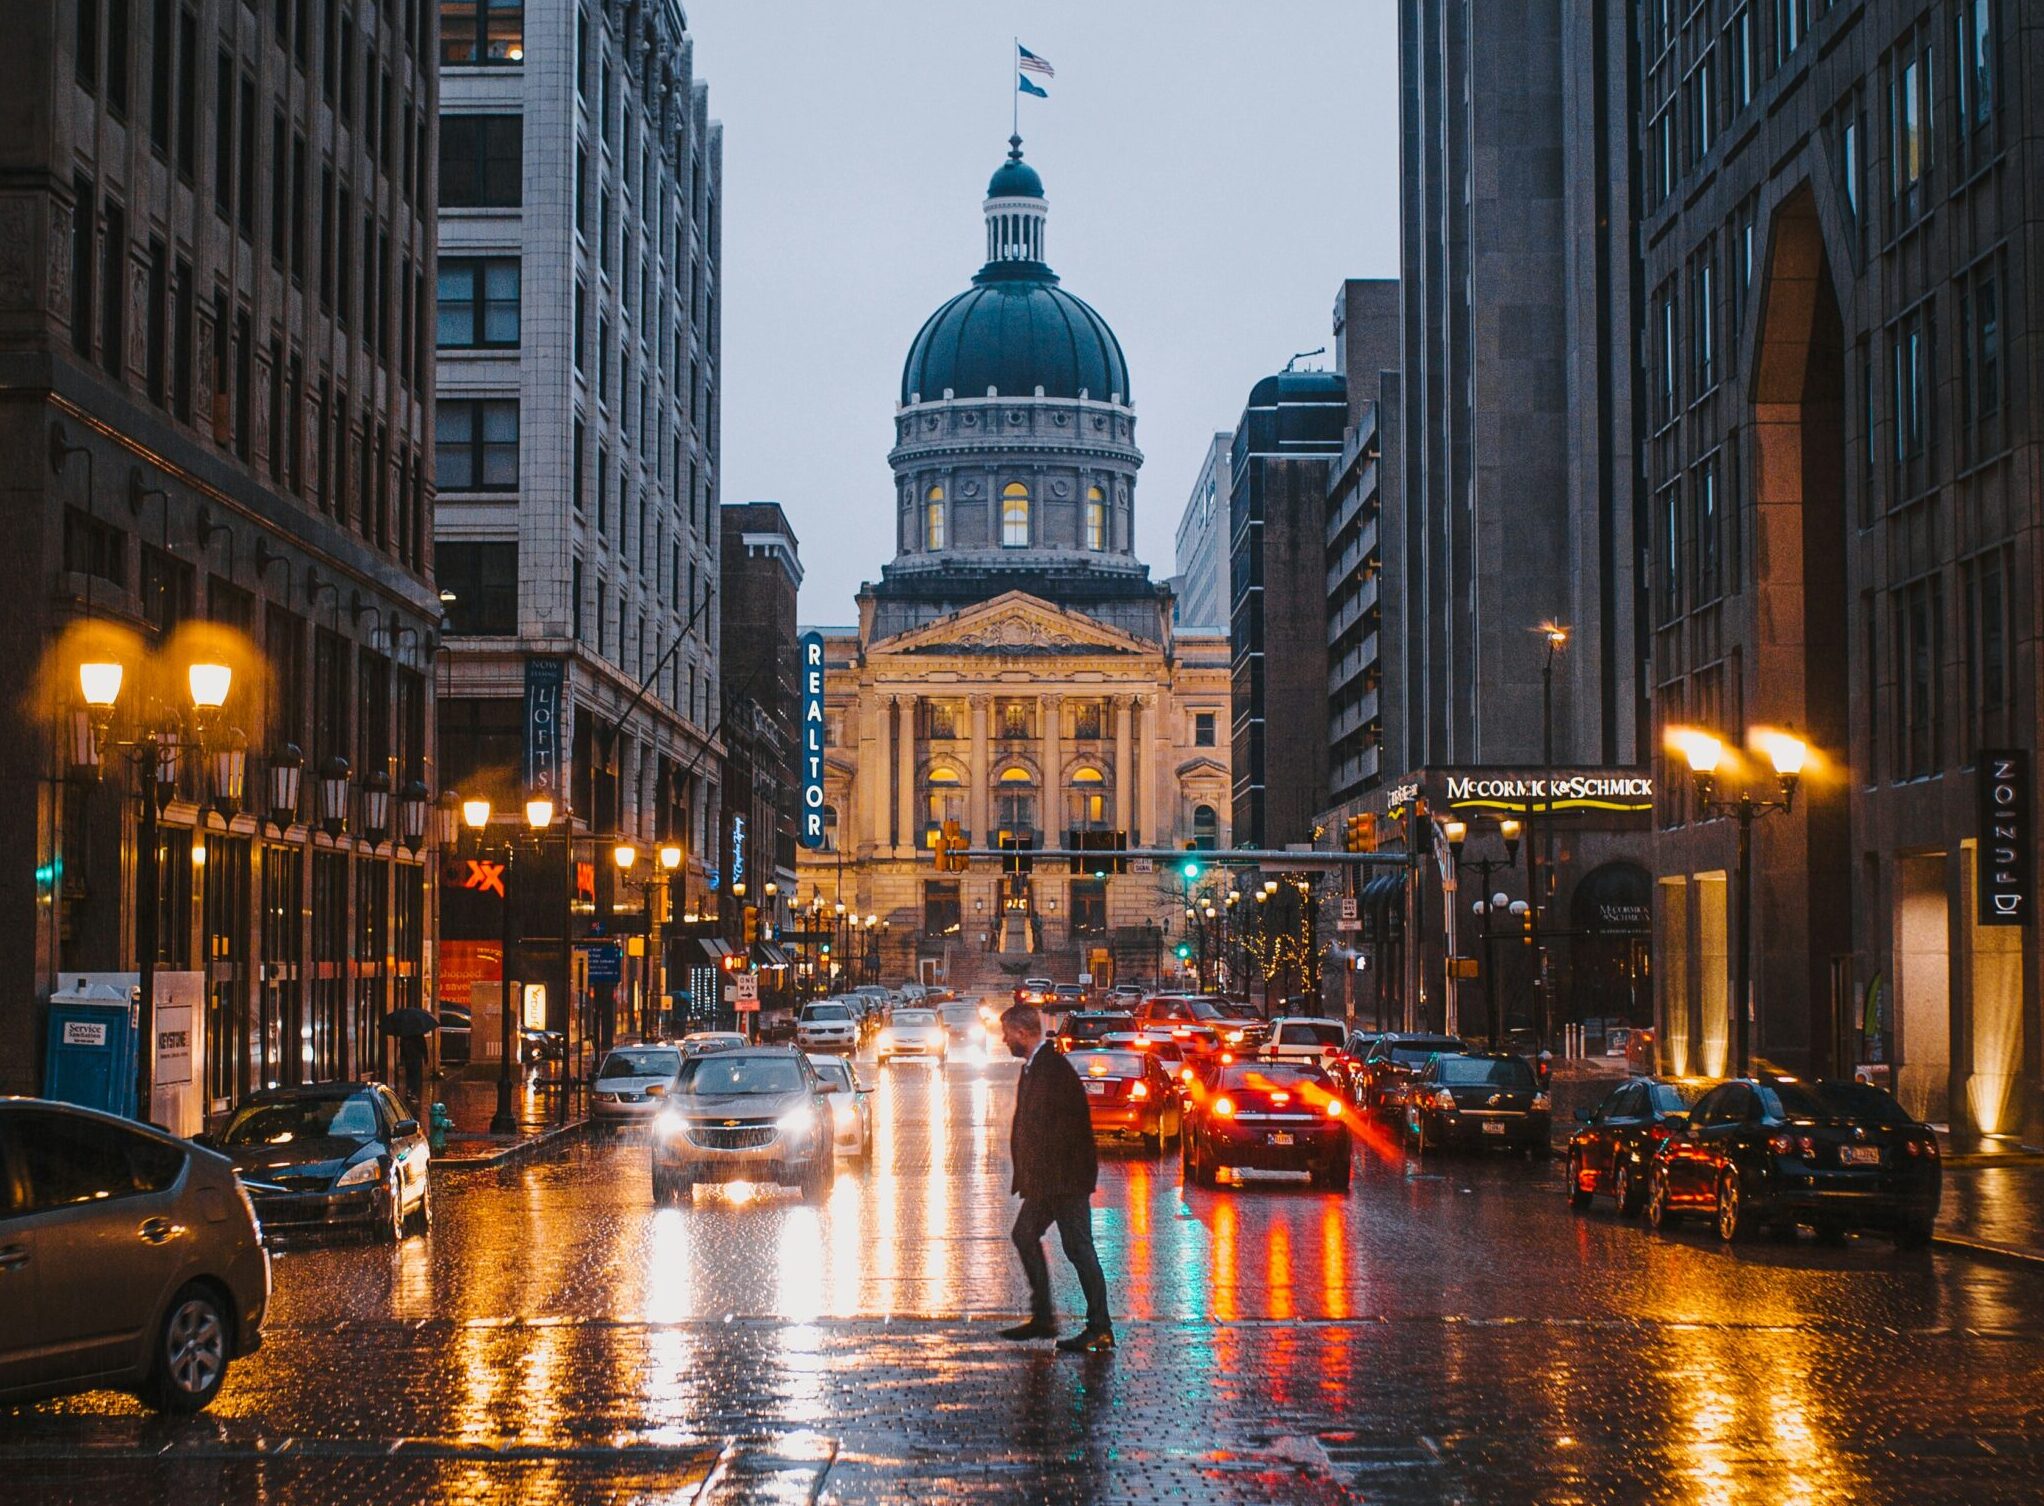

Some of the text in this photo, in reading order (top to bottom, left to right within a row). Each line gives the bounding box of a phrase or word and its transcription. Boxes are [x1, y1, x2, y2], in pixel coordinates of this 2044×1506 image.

[532, 660, 558, 670] NOW
[534, 688, 550, 788] LOFTS
[805, 643, 824, 836] REALTOR
[1994, 760, 2017, 883] FUZION
[69, 1023, 102, 1033] Service
